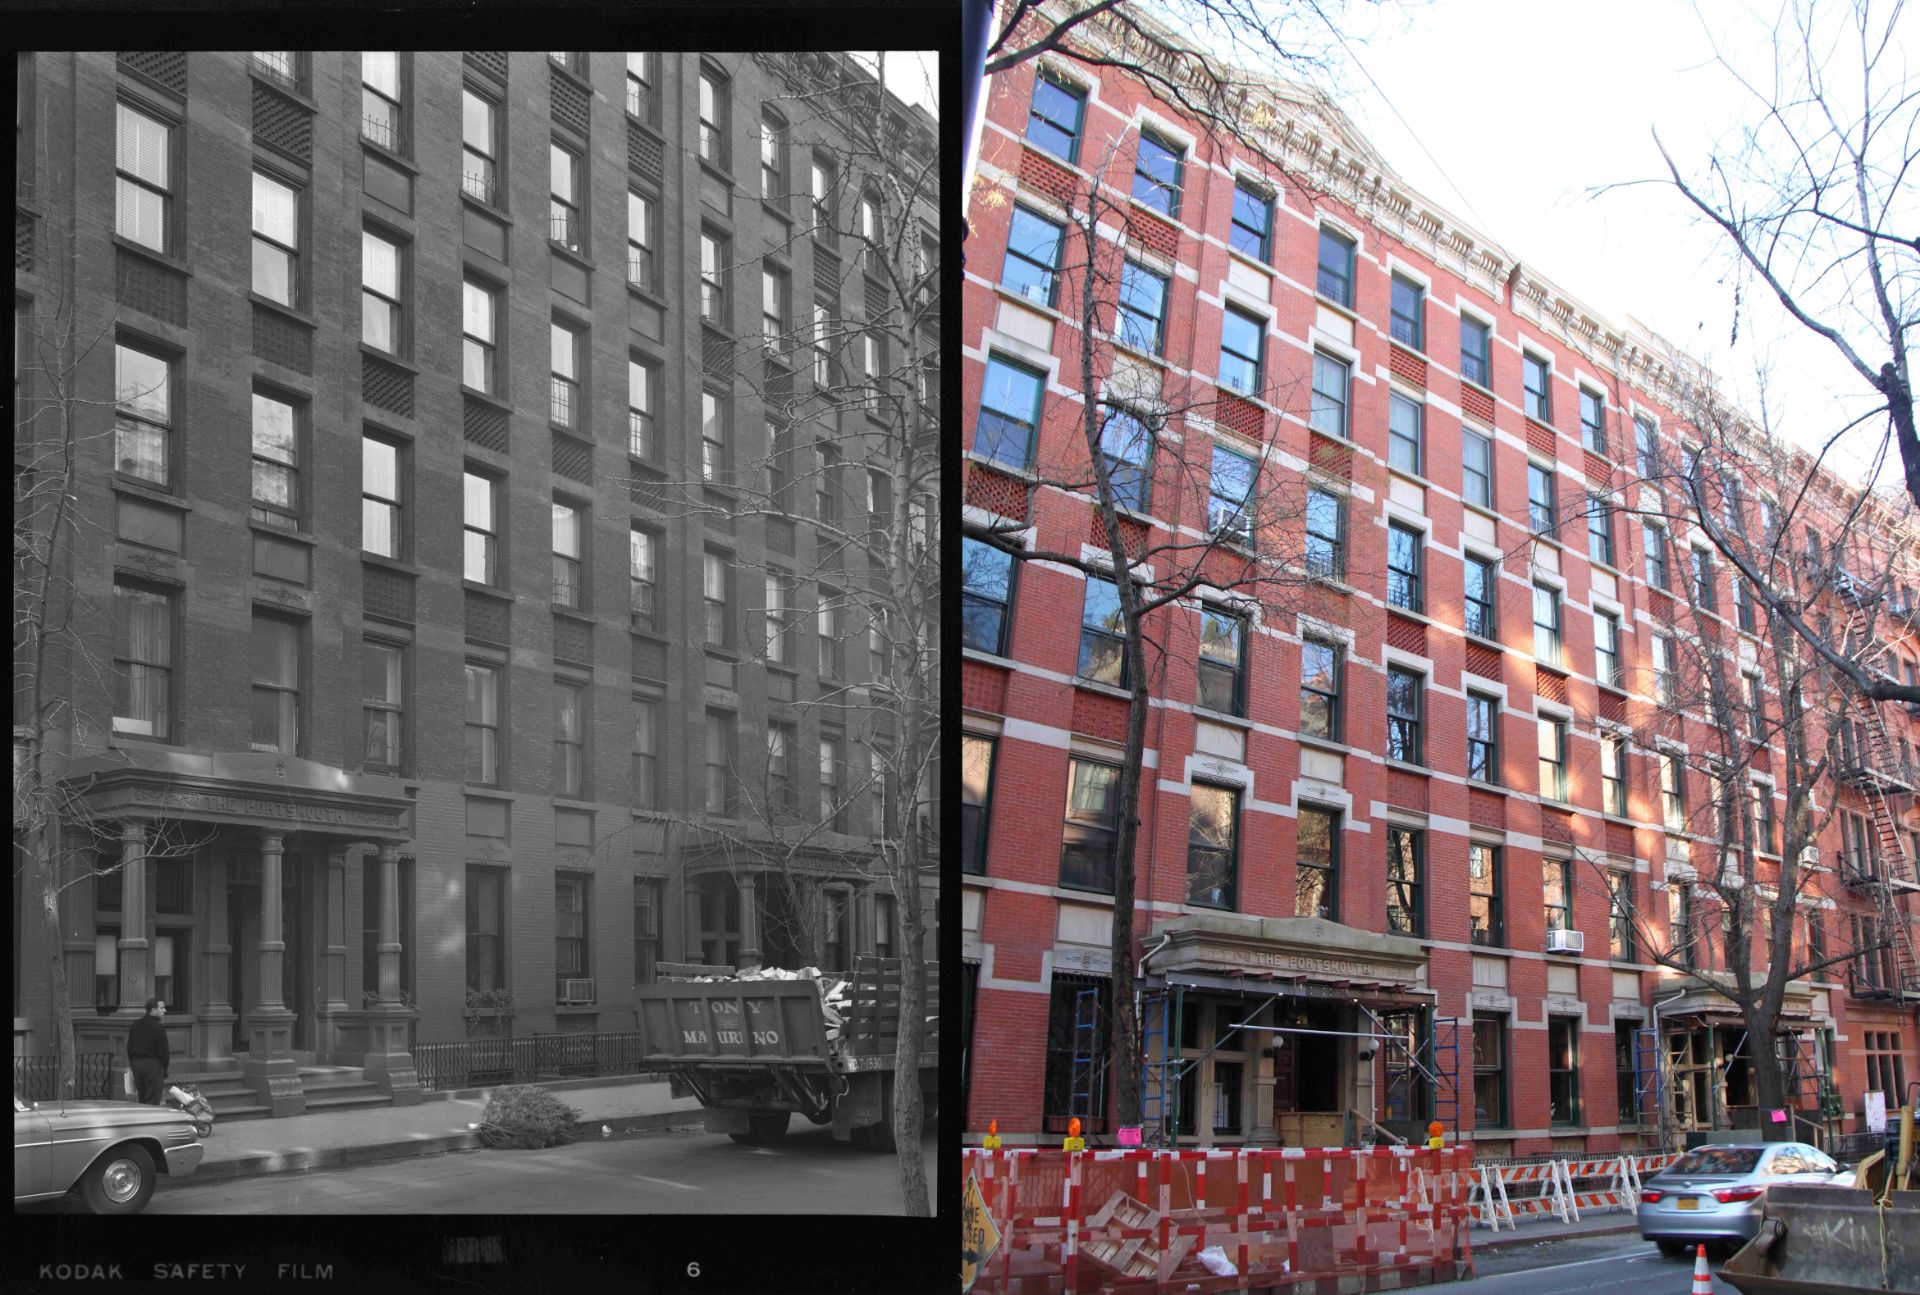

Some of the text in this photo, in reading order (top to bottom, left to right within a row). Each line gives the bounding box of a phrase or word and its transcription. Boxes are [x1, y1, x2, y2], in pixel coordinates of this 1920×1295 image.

[206, 796, 345, 823] THE PORTSMOUTH
[1256, 952, 1371, 976] THE PORTSMOUTH
[689, 1000, 763, 1014] TONY
[40, 1263, 333, 1280] KODAK SAFETY FILM
[687, 1262, 700, 1277] 6
